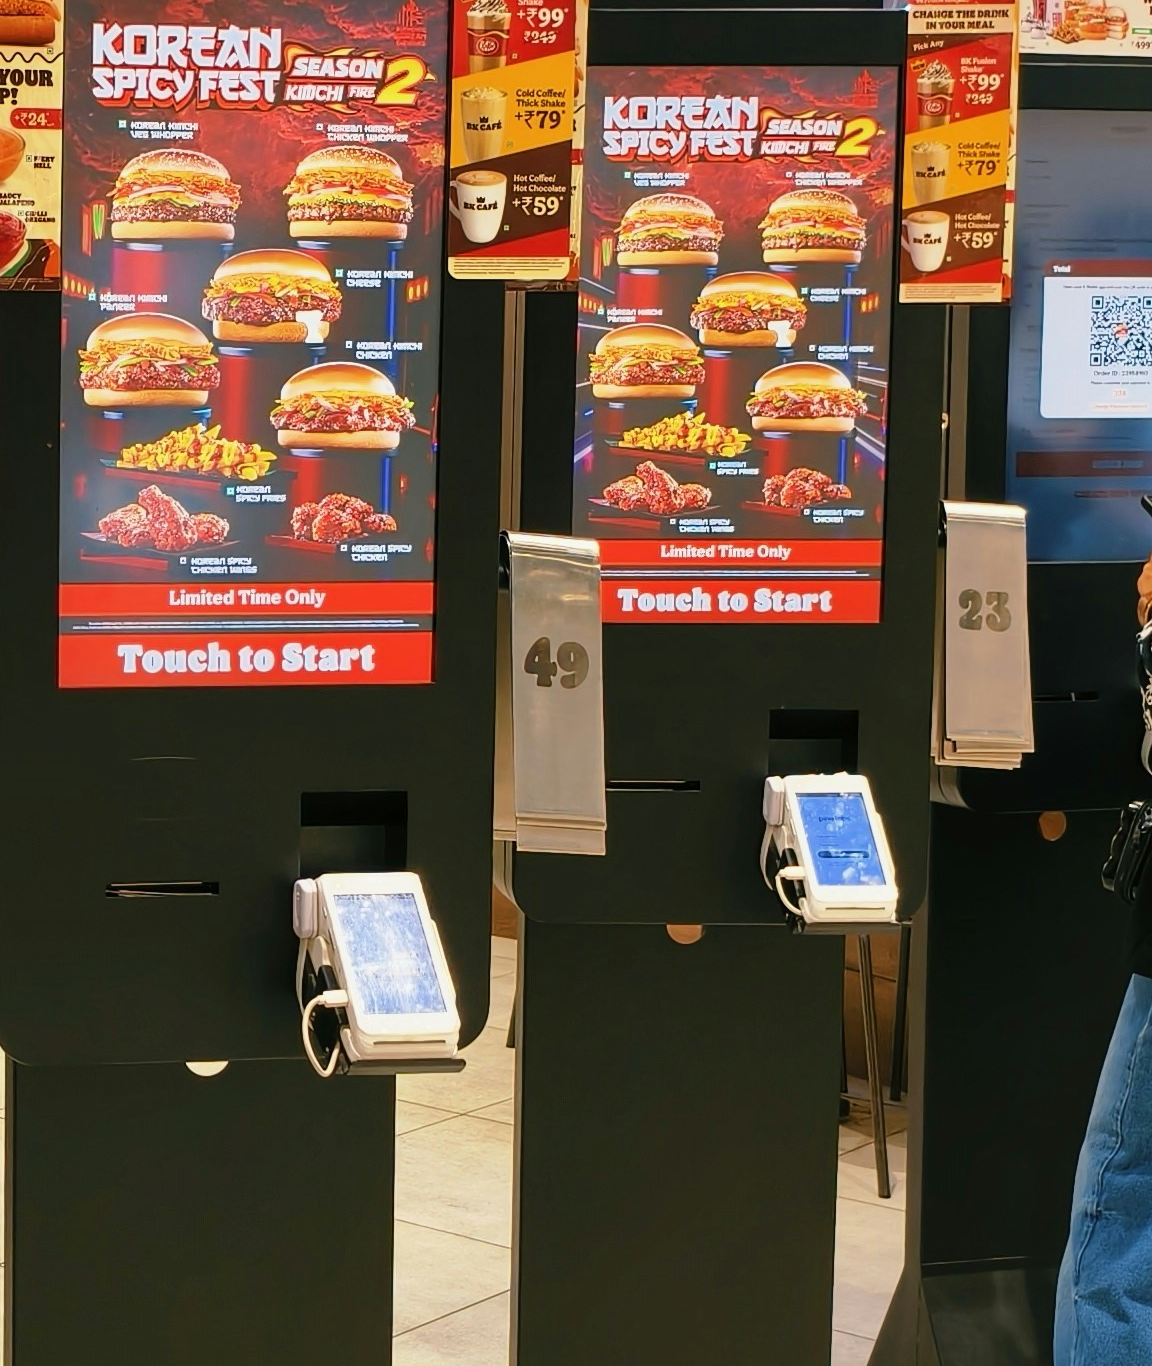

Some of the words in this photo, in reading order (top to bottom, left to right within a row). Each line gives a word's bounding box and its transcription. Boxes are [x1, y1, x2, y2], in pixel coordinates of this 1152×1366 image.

[92, 22, 281, 68] KOREAN
[291, 56, 385, 79] SEASON
[375, 55, 425, 105] 2
[93, 68, 195, 102] SPICY
[199, 69, 281, 103] FEST
[285, 83, 343, 102] KIMCHI
[347, 86, 376, 100] FIRE
[603, 95, 759, 130] KOREAN
[767, 118, 844, 136] SEASON
[602, 131, 687, 157] SPICY
[690, 131, 758, 157] FEST
[835, 117, 878, 157] 2
[660, 544, 715, 559] Limited
[717, 544, 754, 559] Time
[756, 544, 792, 561] Only
[168, 589, 235, 607] Limited
[237, 588, 282, 606] Time
[284, 587, 326, 608] Only
[617, 587, 712, 613] Touch
[717, 589, 748, 612] to
[753, 588, 833, 613] Start
[957, 588, 1012, 632] 23
[117, 641, 231, 674] Touch
[238, 645, 276, 673] to
[281, 642, 376, 673] Start
[523, 636, 590, 690] 49
